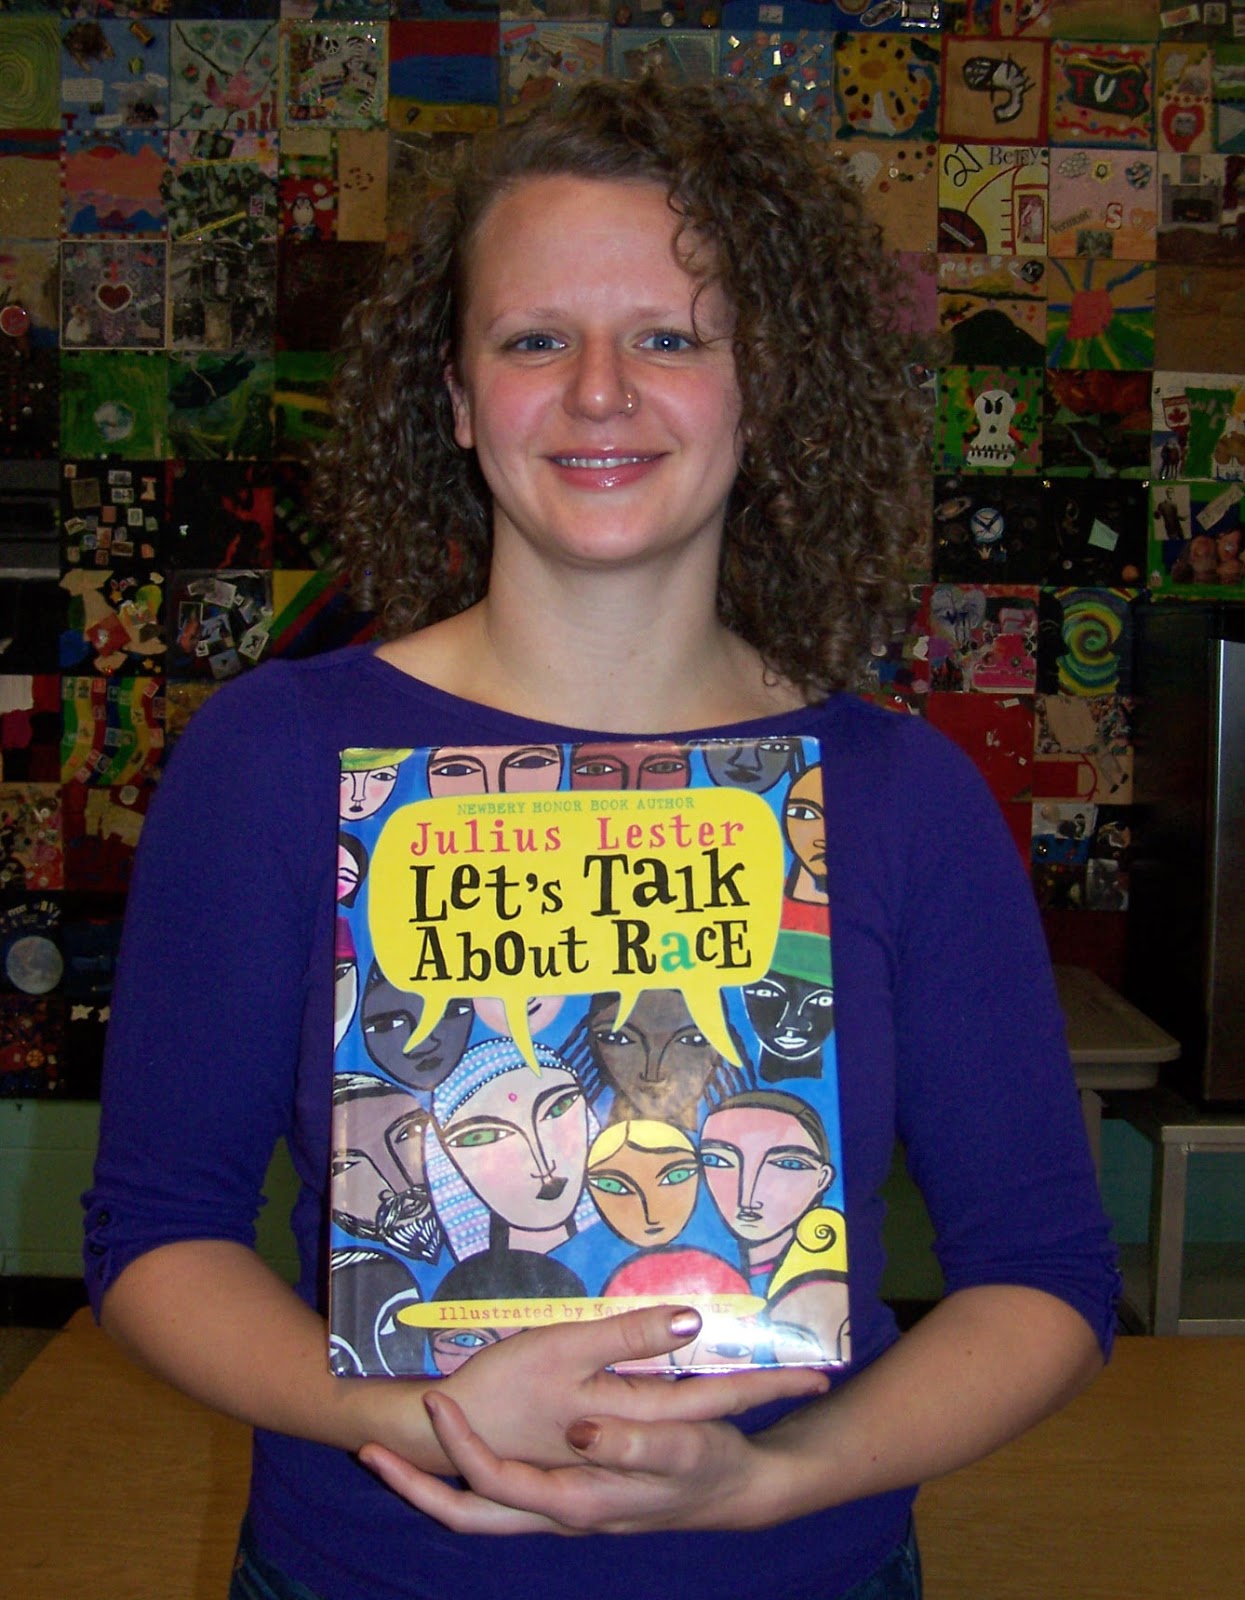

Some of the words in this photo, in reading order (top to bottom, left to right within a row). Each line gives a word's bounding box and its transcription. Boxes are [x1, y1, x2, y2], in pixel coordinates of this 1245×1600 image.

[457, 803, 525, 816] NEWBERY
[532, 801, 582, 813] HONOR
[590, 800, 629, 811] BOOK
[636, 797, 695, 810] AUTHOR
[411, 819, 562, 856] Julius
[597, 814, 744, 850] Lester
[584, 848, 750, 917] Talk
[439, 1305, 551, 1321] Illustrated
[560, 1305, 583, 1320] by
